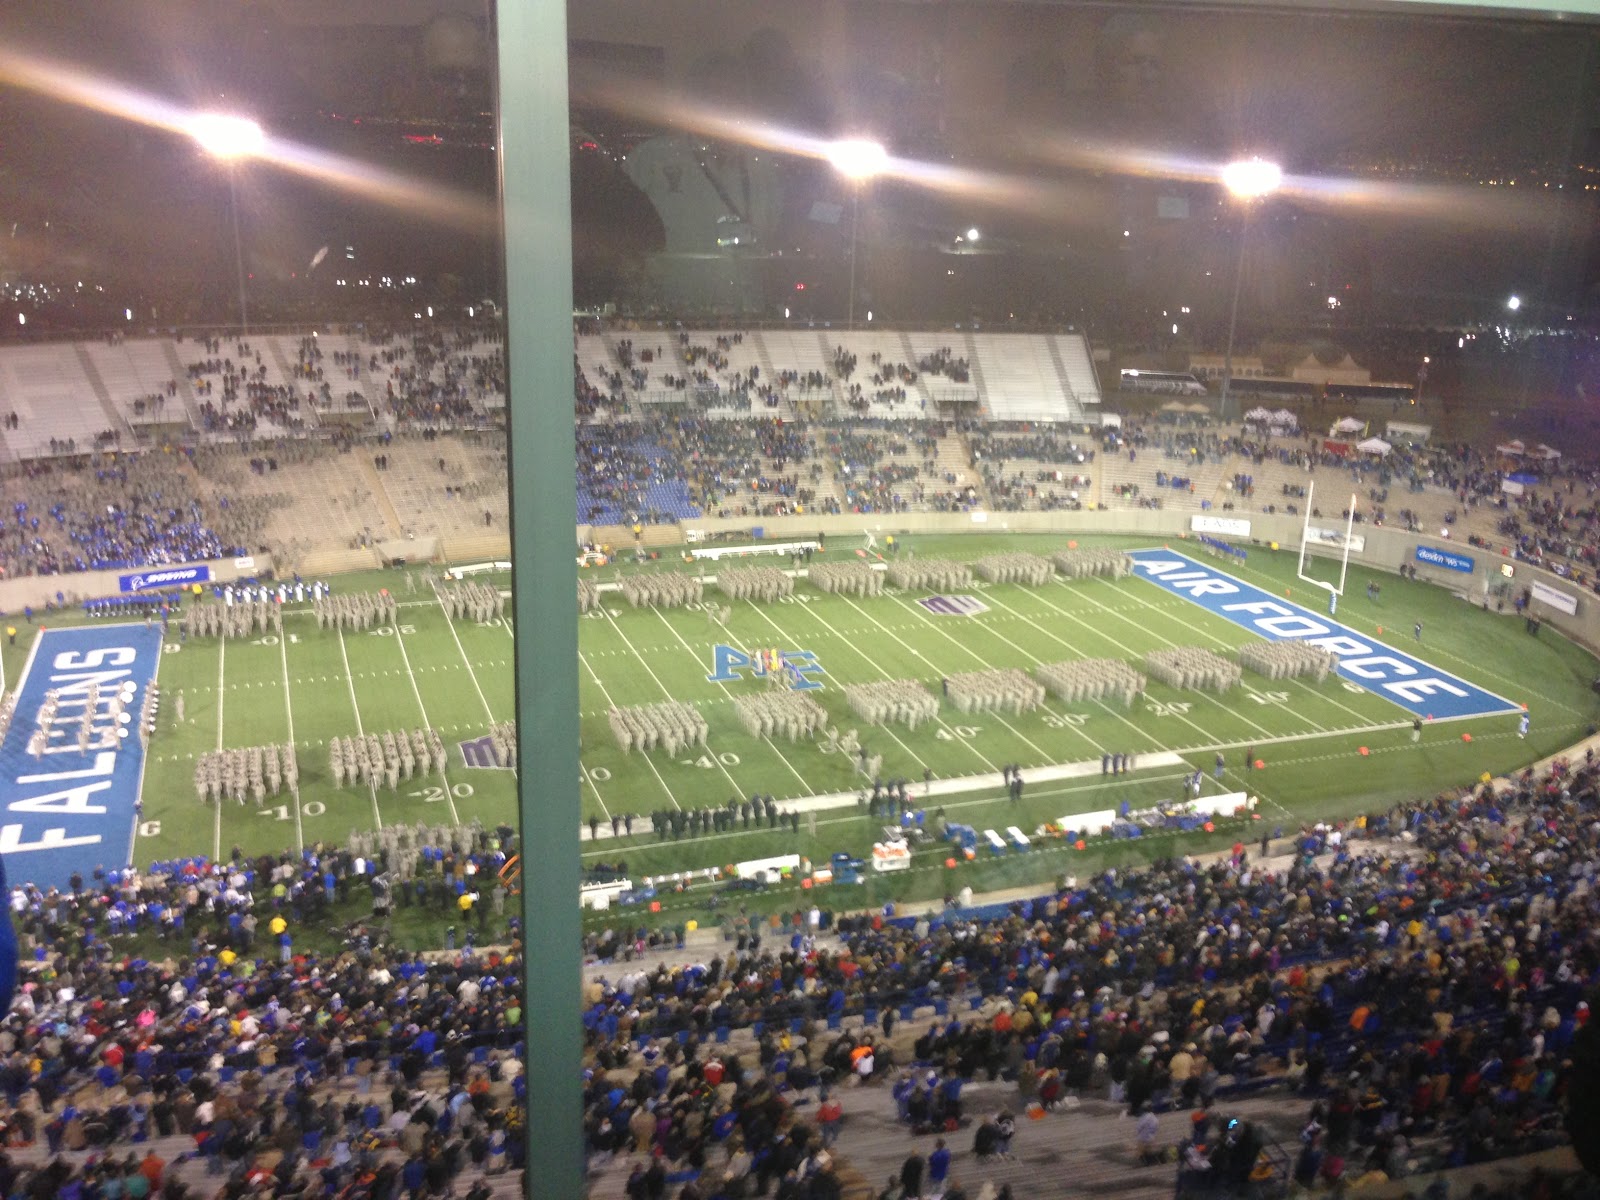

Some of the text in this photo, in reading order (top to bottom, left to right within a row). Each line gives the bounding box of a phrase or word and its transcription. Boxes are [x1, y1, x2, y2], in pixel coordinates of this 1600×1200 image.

[1132, 560, 1470, 703] AIR FORCE
[695, 751, 741, 769] 40
[421, 782, 475, 803] 20
[270, 800, 327, 821] 10
